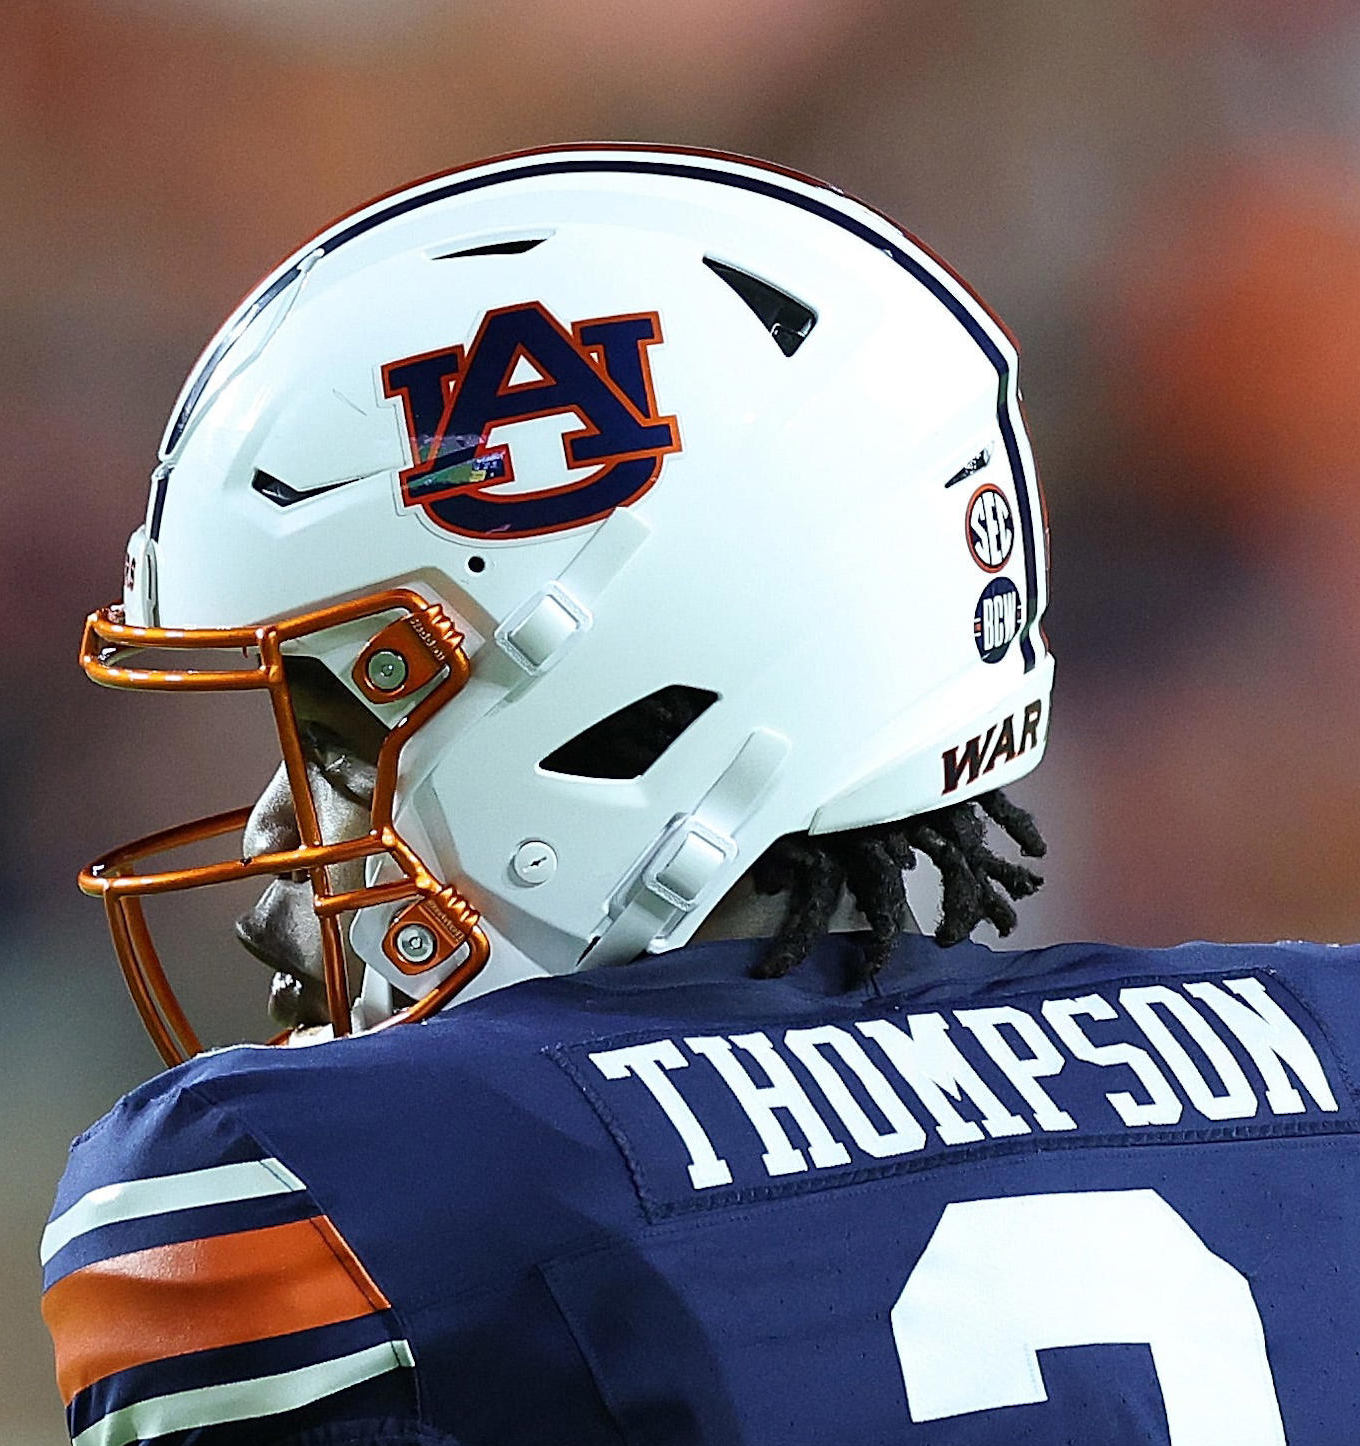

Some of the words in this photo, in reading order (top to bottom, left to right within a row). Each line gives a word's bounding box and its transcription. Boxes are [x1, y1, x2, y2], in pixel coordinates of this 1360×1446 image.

[970, 491, 1014, 566] SEC
[983, 591, 1017, 651] BCW
[941, 699, 1042, 796] WAR
[589, 976, 1340, 1190] THOMPSON
